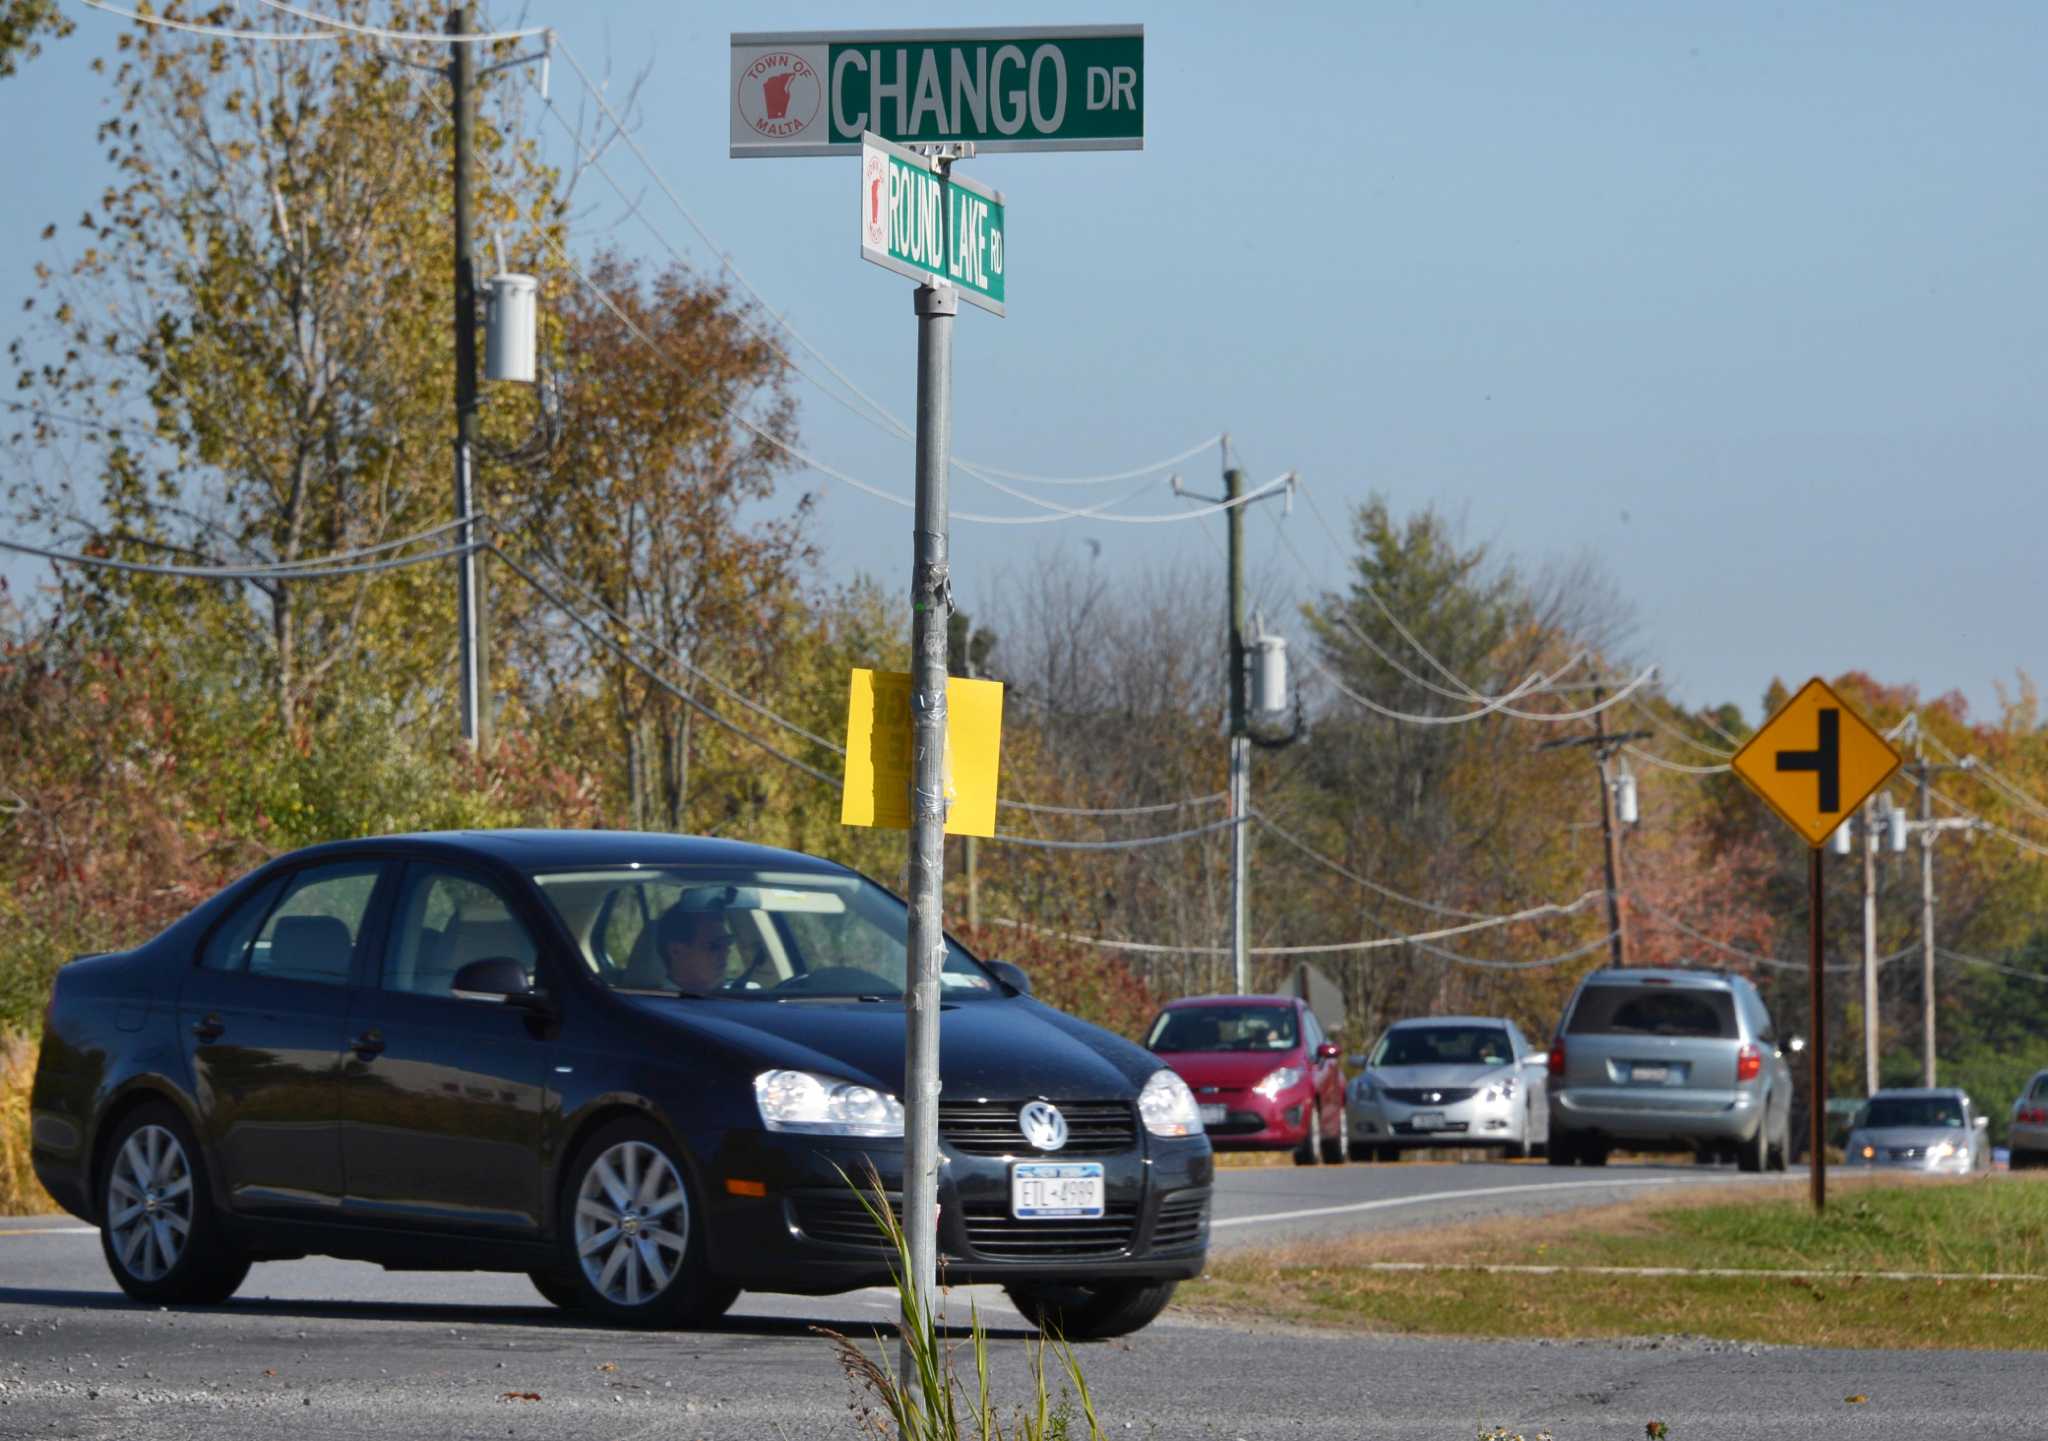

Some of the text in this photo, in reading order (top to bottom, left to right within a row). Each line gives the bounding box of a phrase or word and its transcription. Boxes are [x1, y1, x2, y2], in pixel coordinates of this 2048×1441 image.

[747, 55, 813, 80] TOWN OF
[831, 43, 1137, 138] CHANGO DR
[756, 117, 804, 136] MALTA
[889, 160, 1003, 290] ROUND LAKE RD
